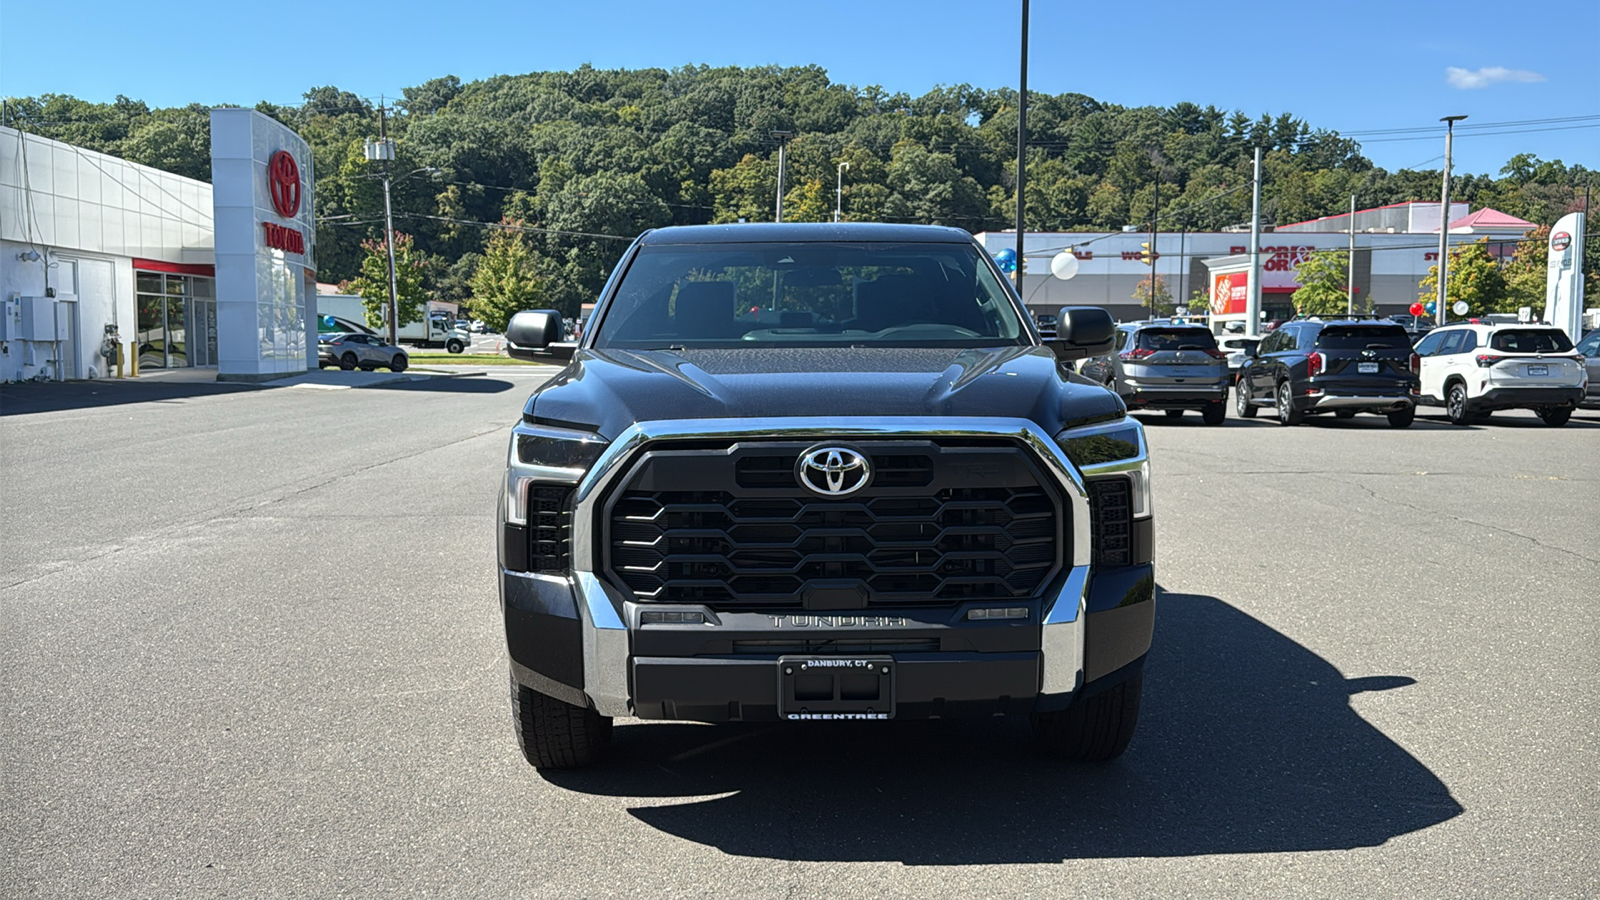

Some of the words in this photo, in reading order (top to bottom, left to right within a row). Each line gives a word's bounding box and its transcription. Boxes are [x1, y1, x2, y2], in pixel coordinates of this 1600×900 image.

[262, 222, 304, 255] TOYOTA
[1121, 251, 1160, 260] WOD
[766, 615, 906, 628] TUNDRA
[807, 660, 853, 668] DANBURY,
